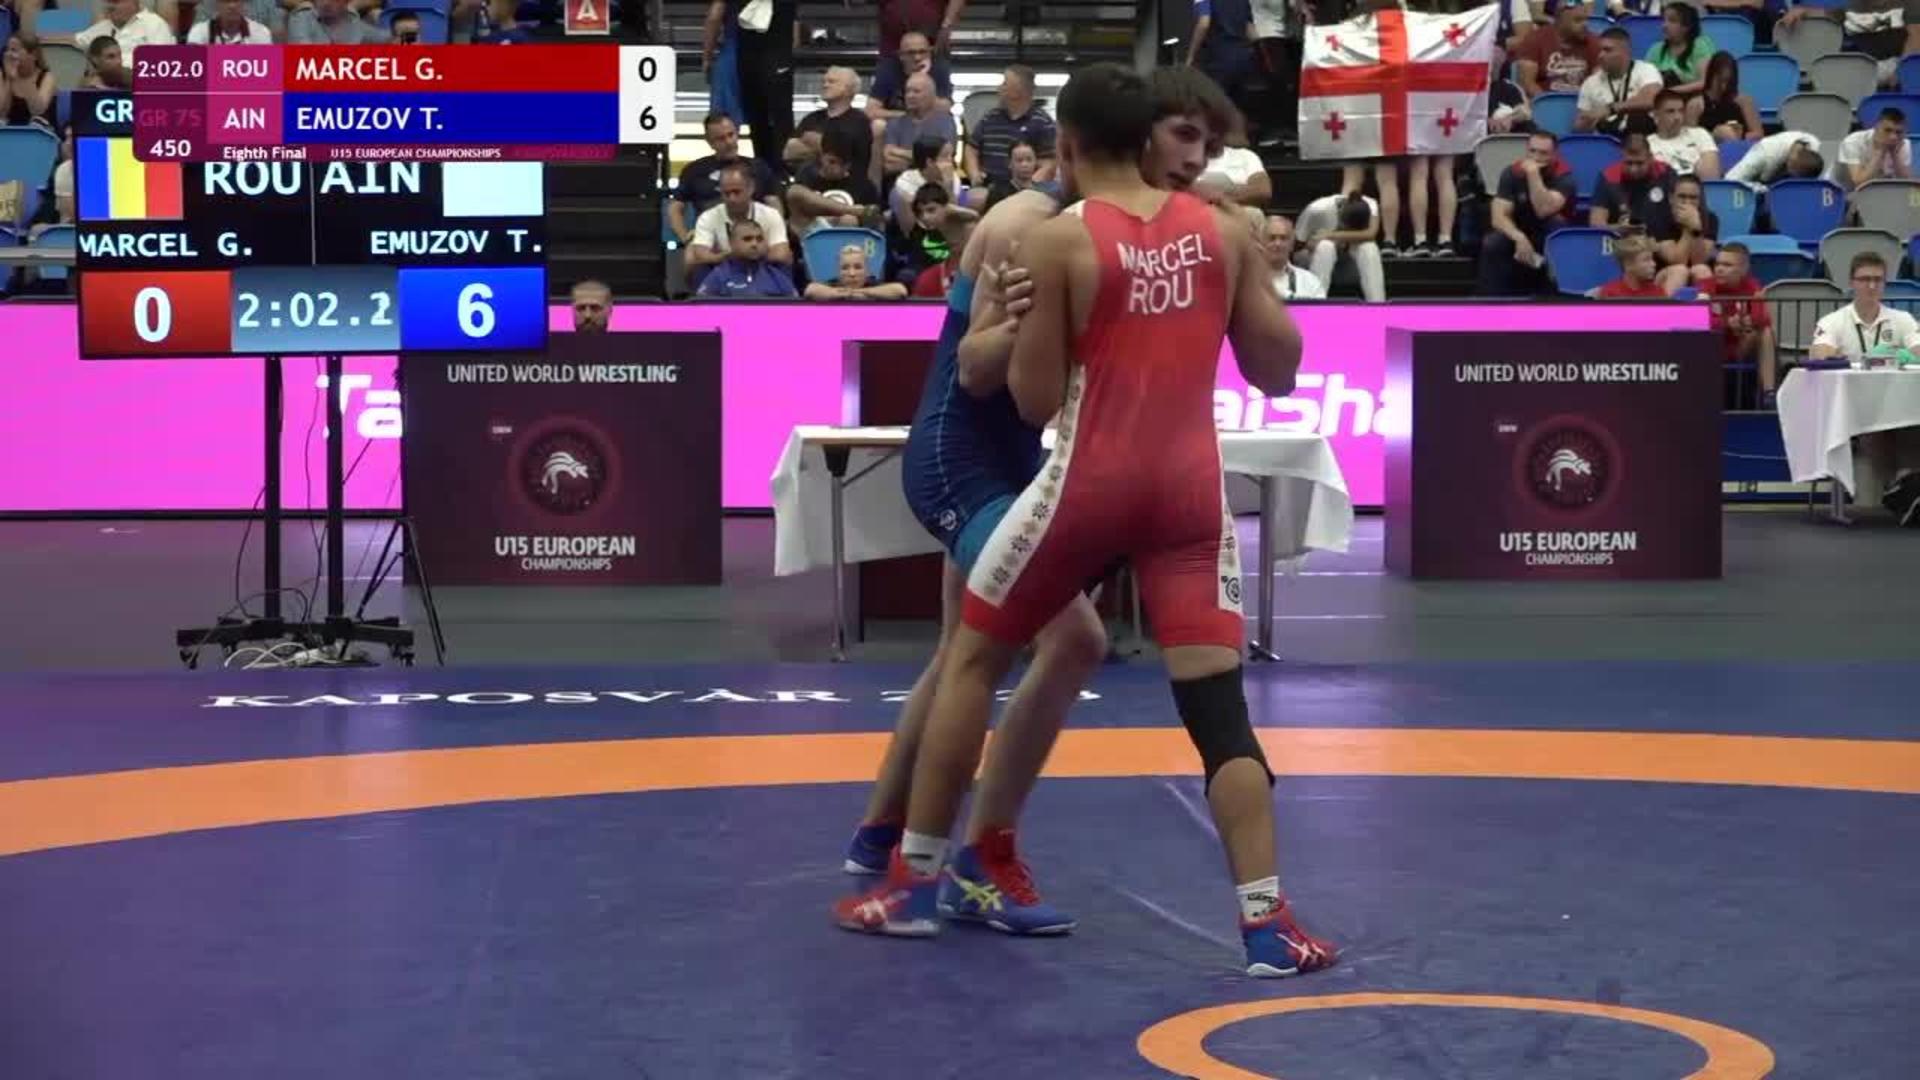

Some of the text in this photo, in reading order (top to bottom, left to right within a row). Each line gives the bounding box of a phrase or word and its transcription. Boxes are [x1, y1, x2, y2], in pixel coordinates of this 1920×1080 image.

[204, 161, 302, 195] ROU
[320, 161, 421, 194] AIN
[79, 231, 253, 258] MARCEL G.
[370, 229, 543, 255] EMUZOV T.
[1116, 232, 1213, 278] MARCEL
[1128, 268, 1195, 315] ROU
[133, 286, 173, 343] 0
[457, 282, 496, 338] 6
[447, 365, 678, 383] UNITED WORLD WRESTLING
[1455, 363, 1679, 382] UNITED WORLD WRESTLING
[494, 536, 635, 556] U15 EUROPEAN
[1500, 531, 1637, 551] U15 EUROPEAN
[521, 558, 612, 571] CHAMPIONSHIPS
[1525, 553, 1614, 565] CHAMPIONSHIPS
[194, 688, 851, 707] KAPOSVÁR
